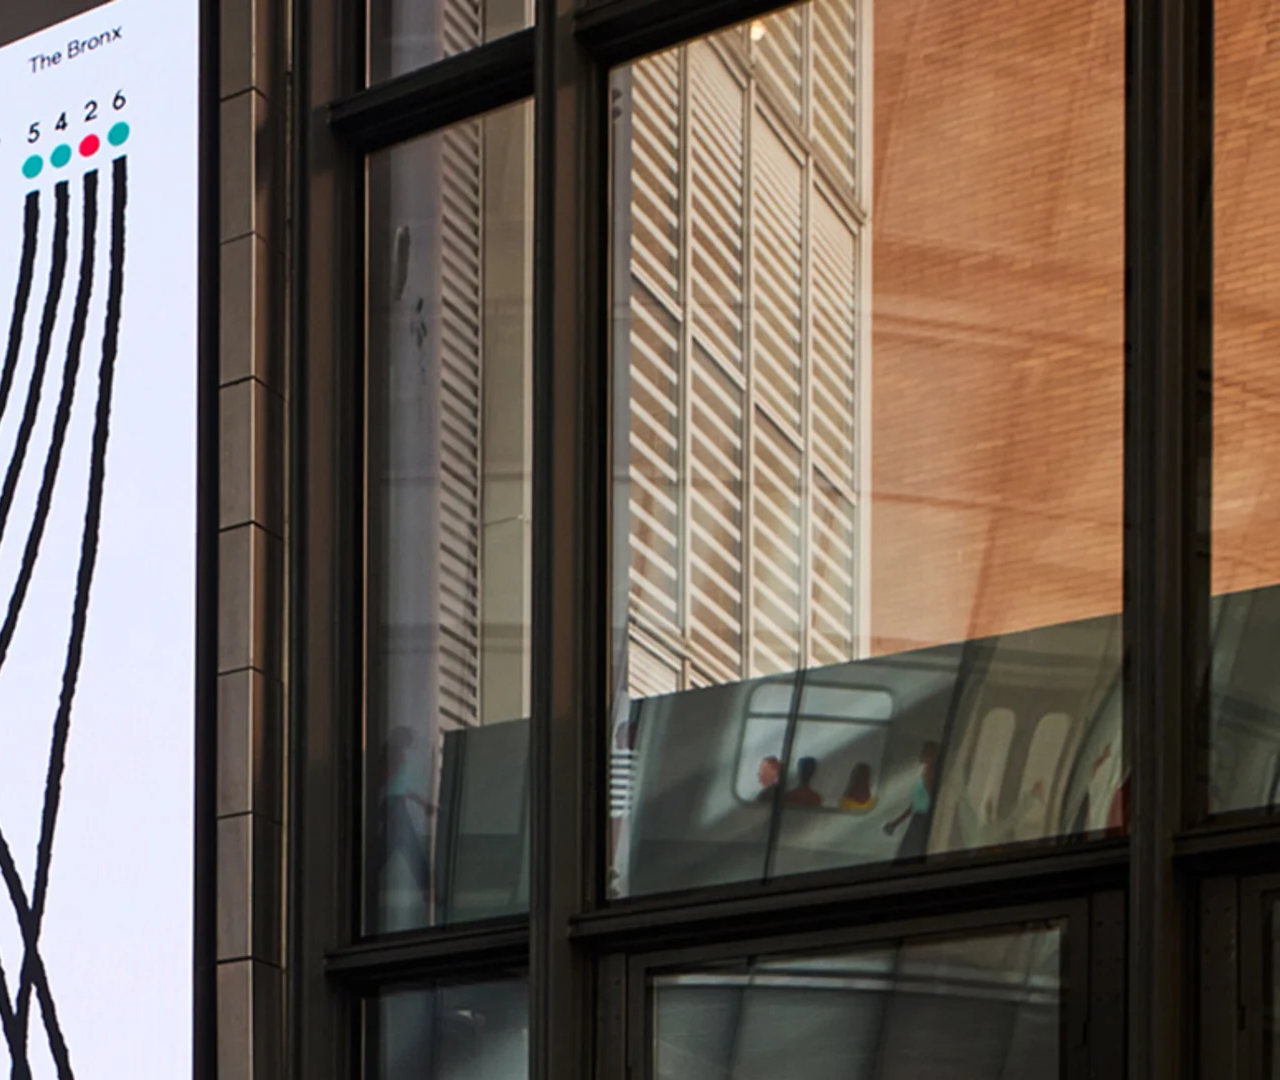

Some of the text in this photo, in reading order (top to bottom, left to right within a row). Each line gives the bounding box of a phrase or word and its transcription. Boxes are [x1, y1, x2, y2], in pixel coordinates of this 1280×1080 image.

[28, 26, 123, 74] The Bronx
[26, 89, 127, 144] 5 4 2 6
